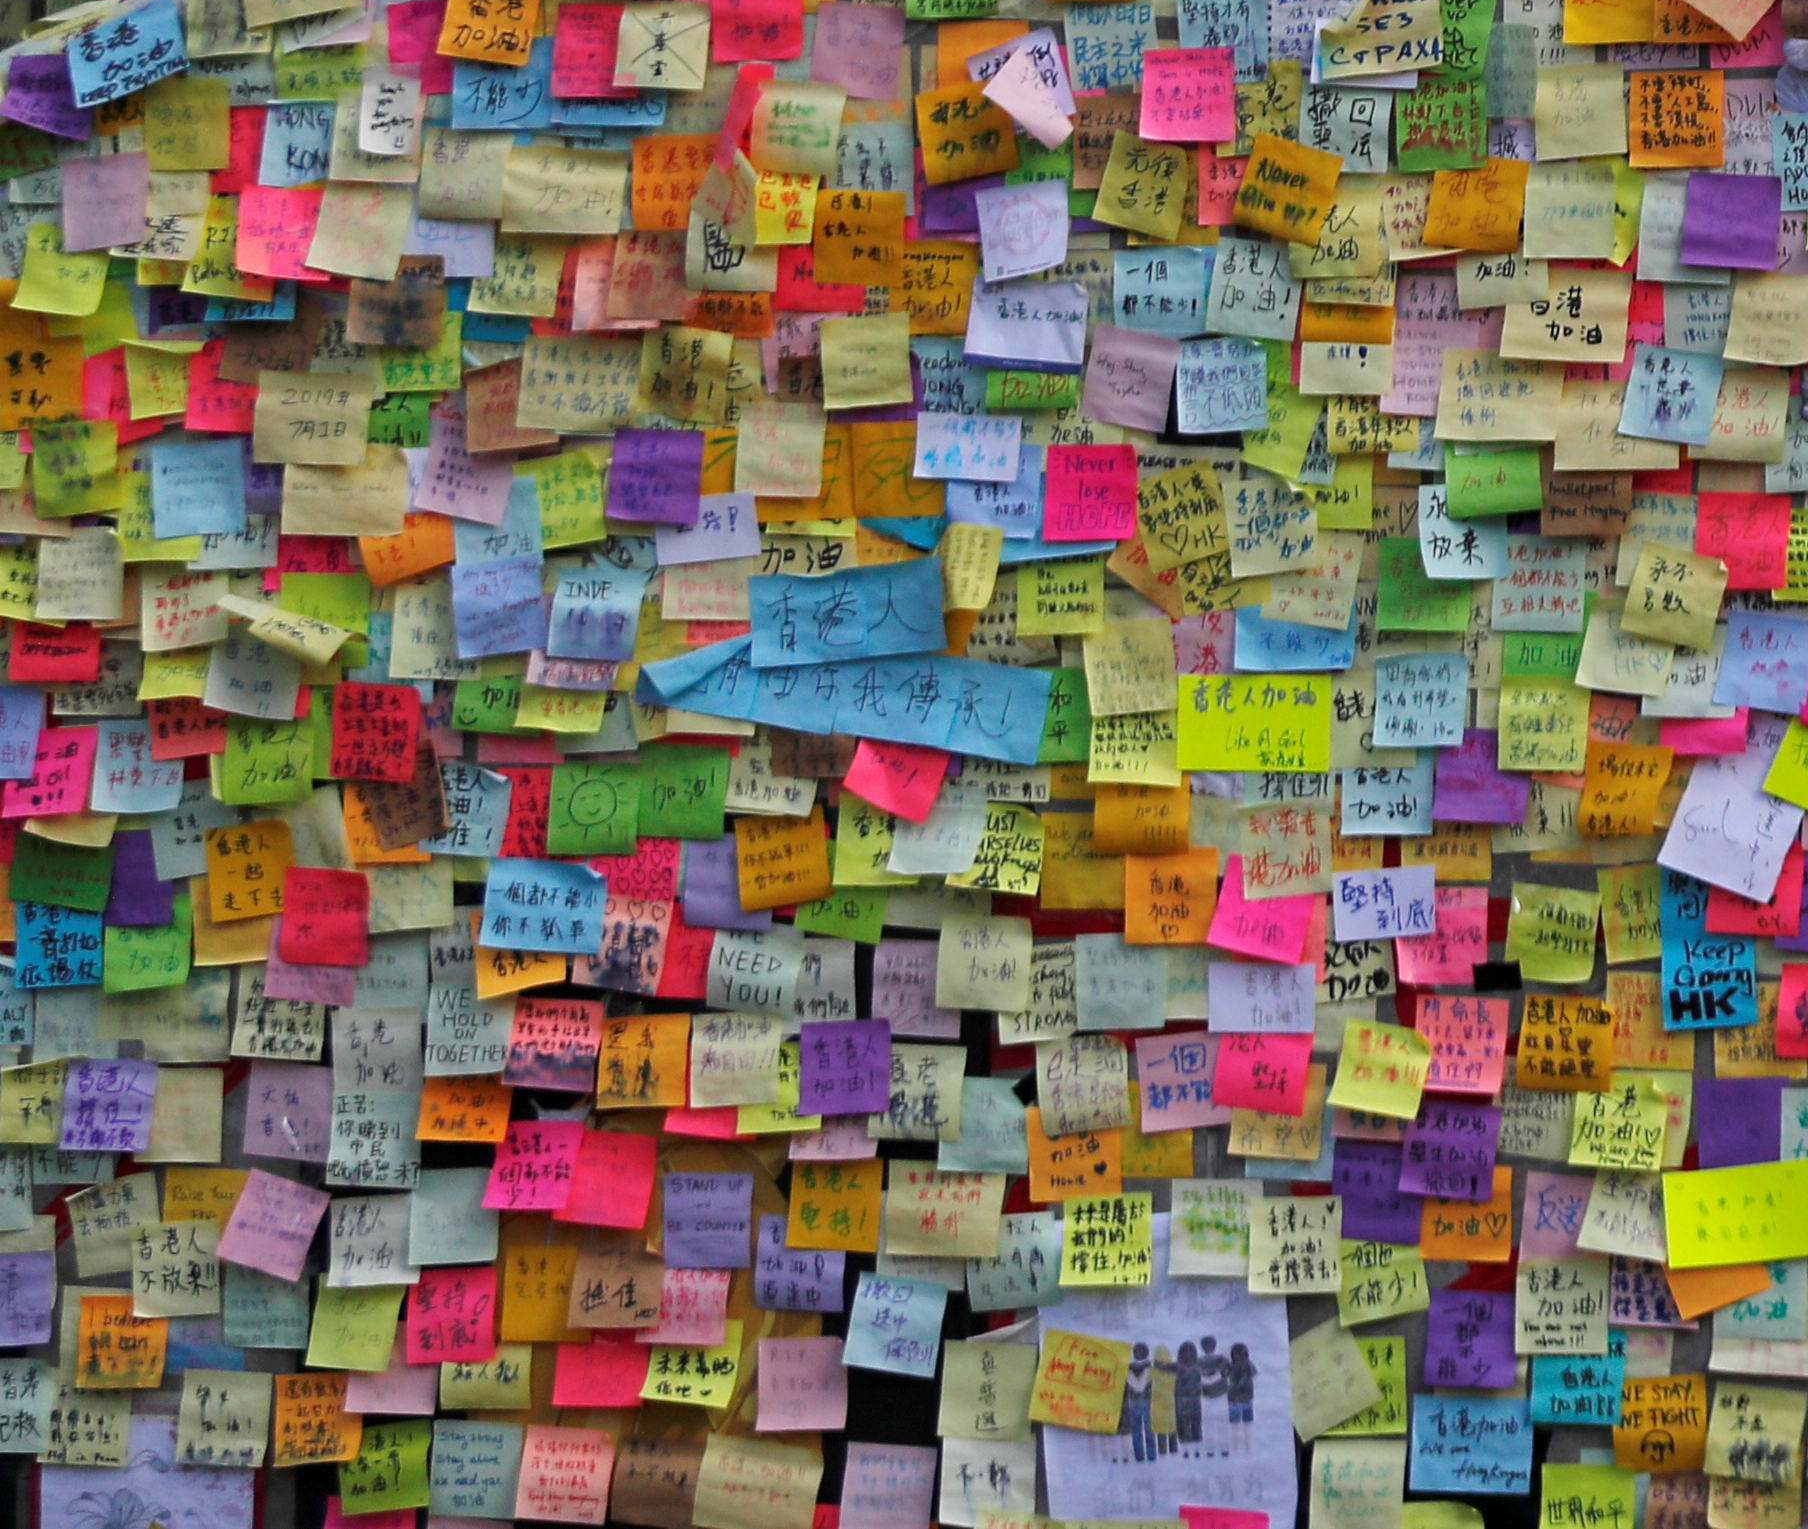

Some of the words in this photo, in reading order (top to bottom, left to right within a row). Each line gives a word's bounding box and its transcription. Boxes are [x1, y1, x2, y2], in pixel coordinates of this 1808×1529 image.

[718, 949, 782, 973] NEED
[721, 978, 782, 1006] YOU!
[1669, 988, 1736, 1020] HK
[441, 1011, 494, 1028] HOLD
[452, 1028, 478, 1041] ON
